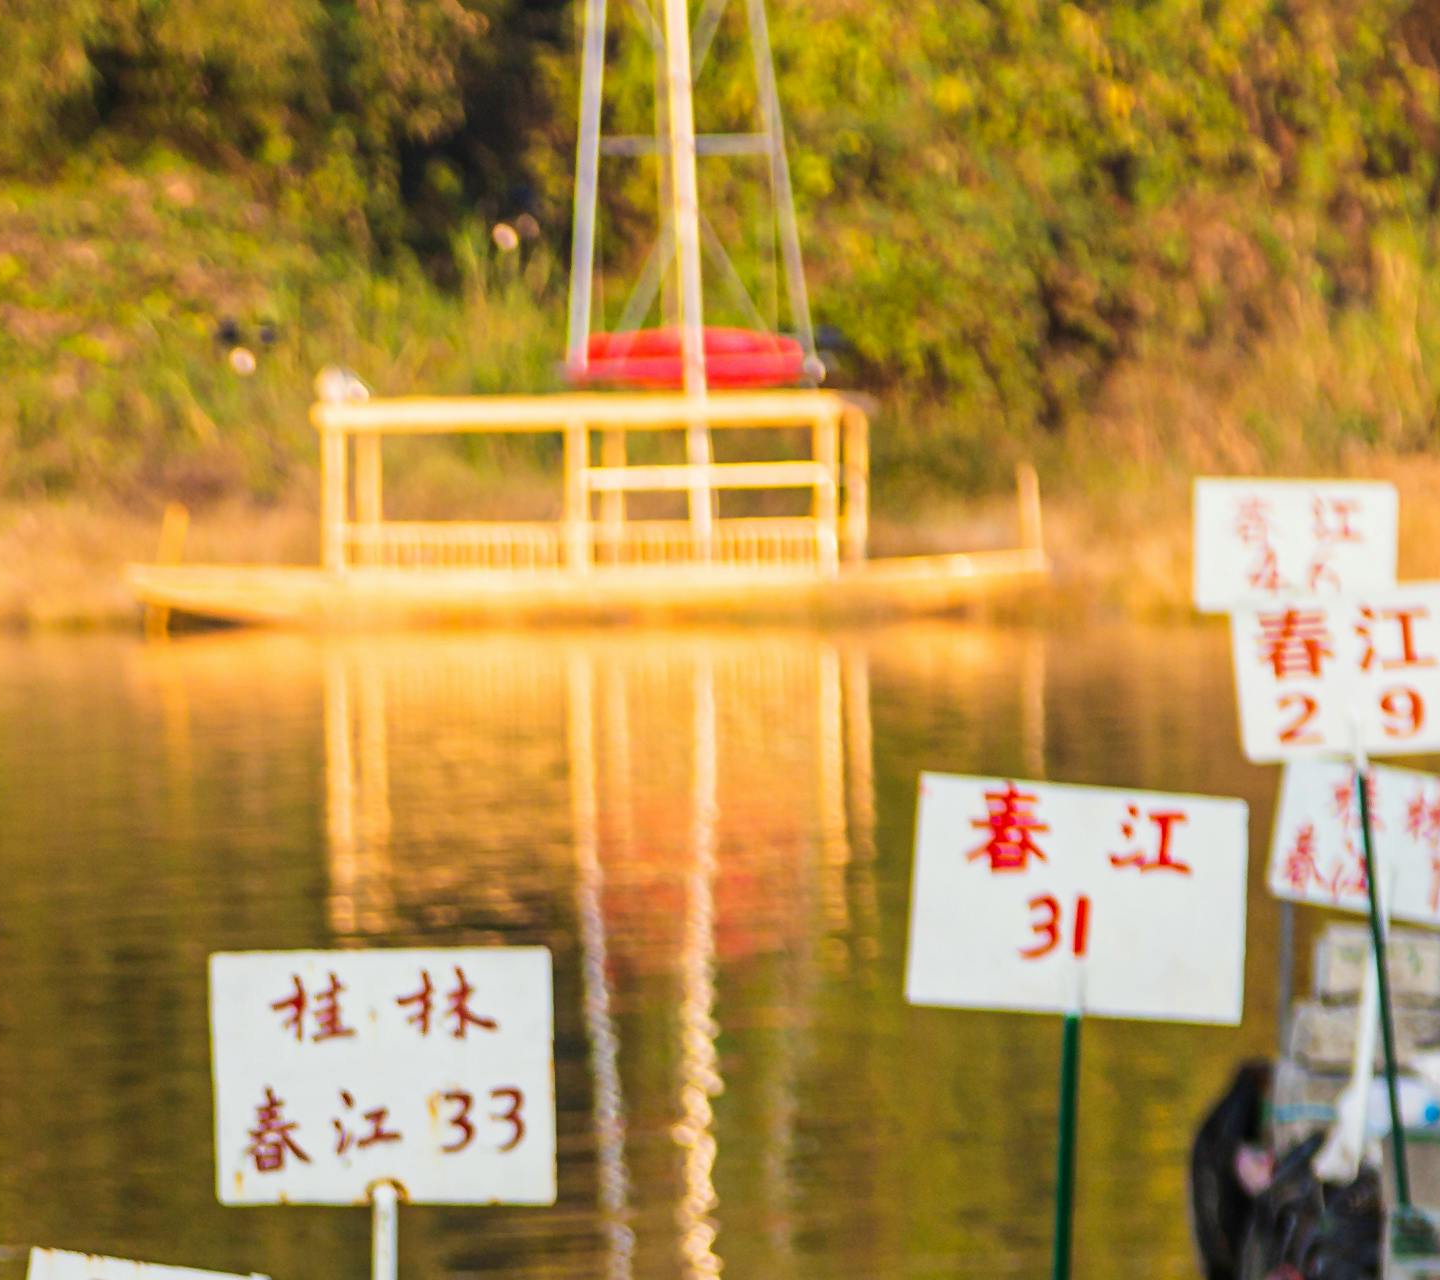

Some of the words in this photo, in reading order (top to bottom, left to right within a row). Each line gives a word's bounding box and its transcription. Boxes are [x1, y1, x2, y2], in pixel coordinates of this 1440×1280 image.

[1256, 604, 1439, 683] 春江
[1277, 687, 1427, 746] 29
[965, 780, 1193, 877] 春江
[1018, 892, 1093, 962] 31
[270, 965, 499, 1043] 桂林
